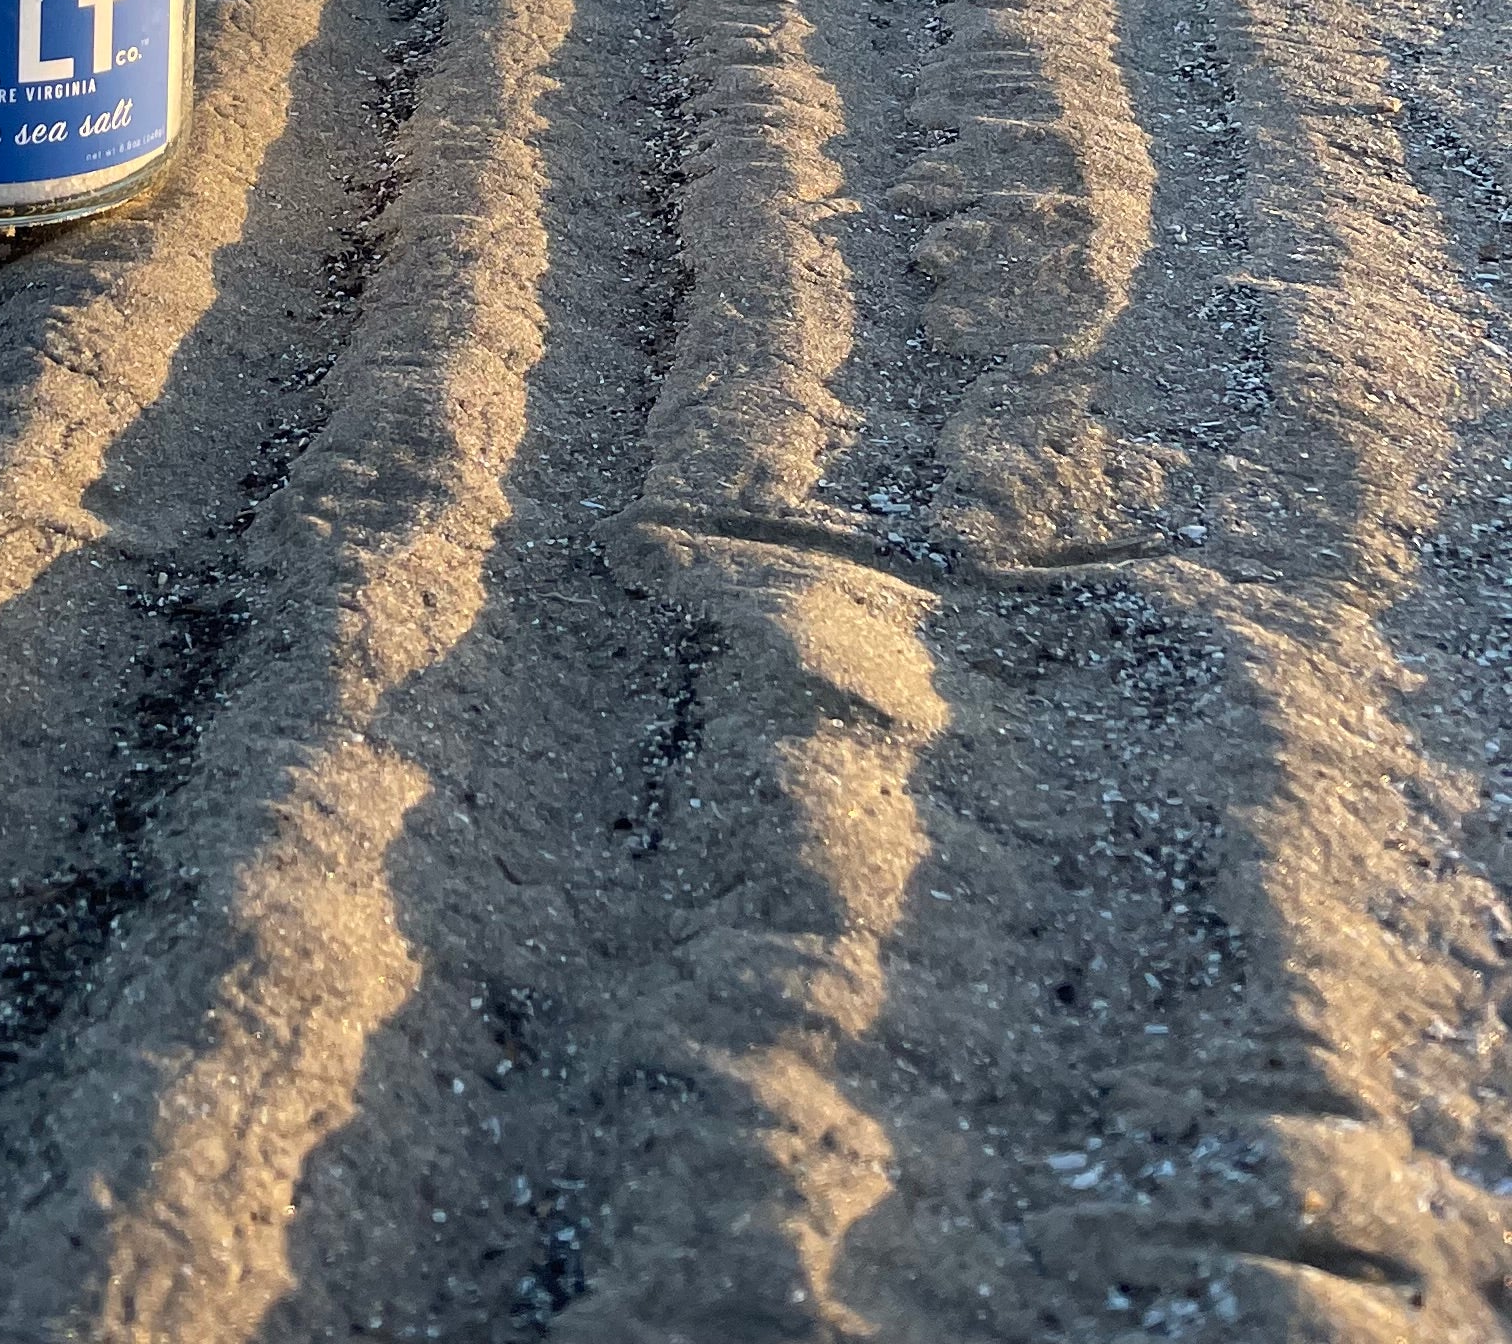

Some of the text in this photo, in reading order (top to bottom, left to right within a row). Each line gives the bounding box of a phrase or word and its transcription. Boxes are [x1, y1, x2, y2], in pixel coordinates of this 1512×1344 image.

[25, 78, 97, 102] VIRGINIA
[14, 119, 69, 146] sea
[78, 98, 136, 138] salt
